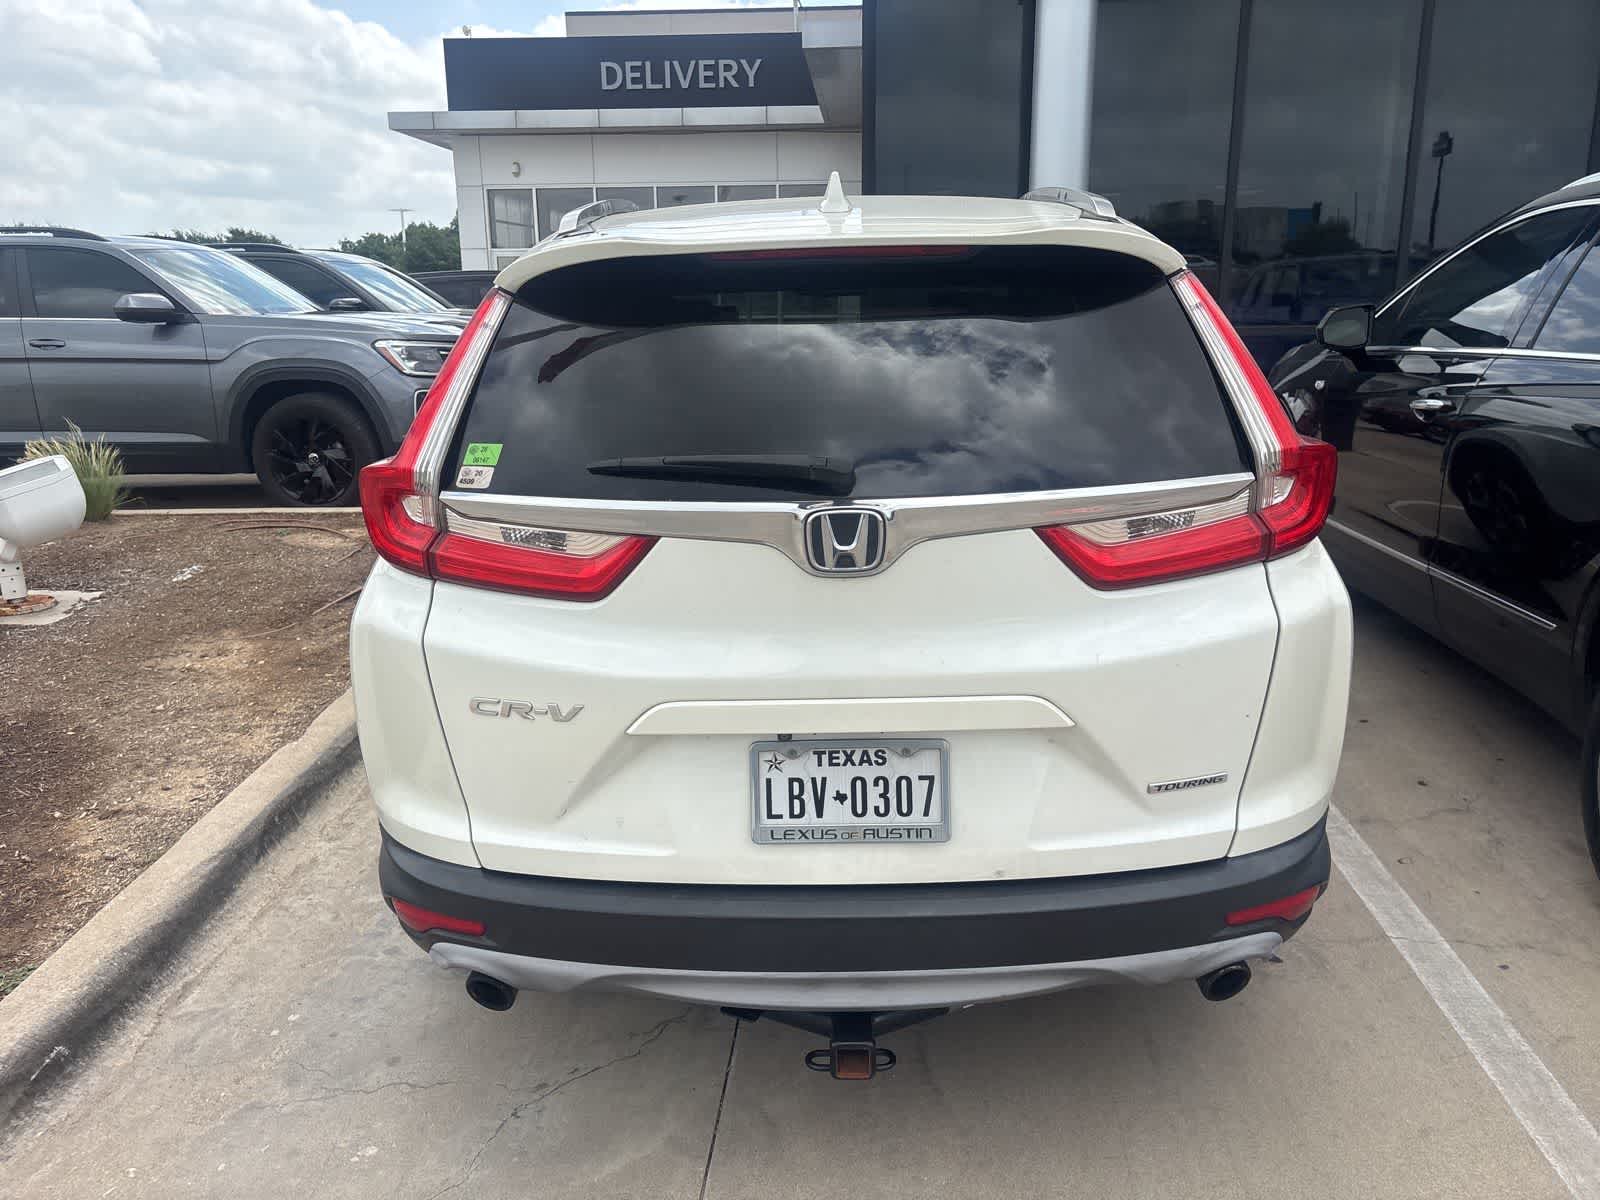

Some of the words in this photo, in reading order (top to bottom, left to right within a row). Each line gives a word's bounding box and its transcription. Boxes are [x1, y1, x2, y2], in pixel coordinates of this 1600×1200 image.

[600, 58, 762, 90] DELIVERY
[469, 697, 585, 722] CR-V
[813, 749, 888, 767] TEXAS
[1153, 774, 1226, 792] TOURING
[765, 776, 827, 819] LBV
[850, 775, 936, 818] 0307
[770, 829, 838, 840] LEXUS
[863, 827, 933, 840] AUSTIN
